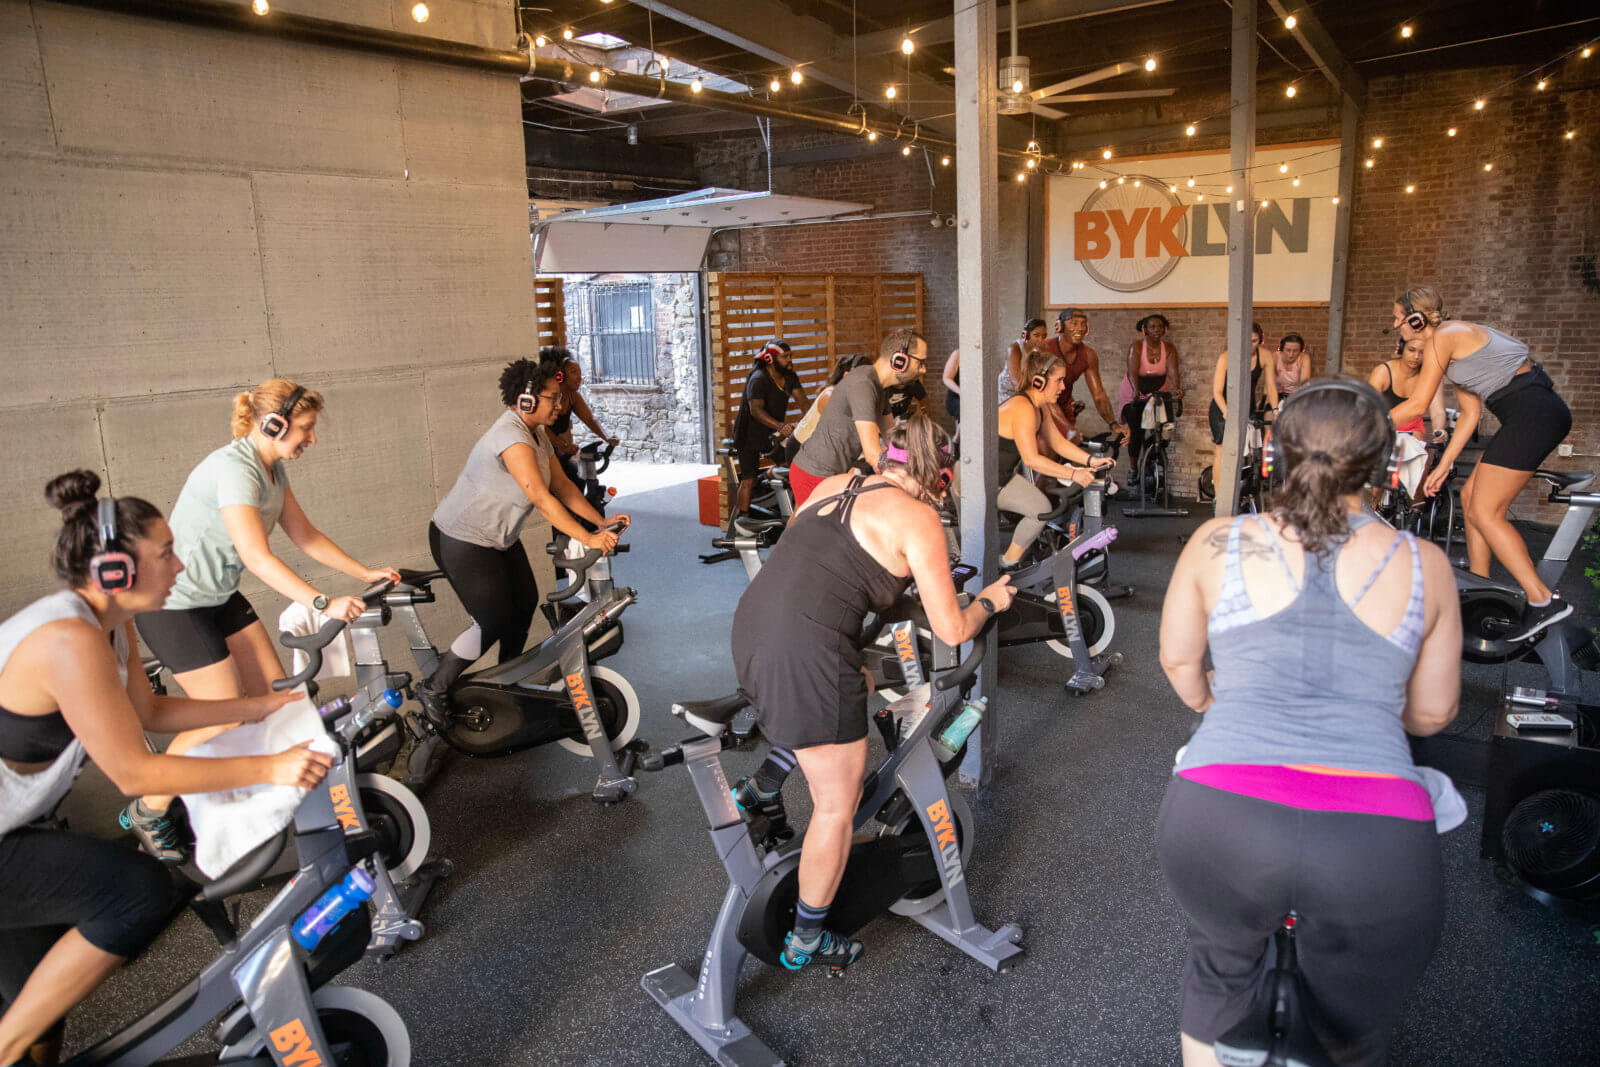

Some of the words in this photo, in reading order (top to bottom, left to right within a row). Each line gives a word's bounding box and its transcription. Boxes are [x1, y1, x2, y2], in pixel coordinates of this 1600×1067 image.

[1057, 586, 1080, 641] BYKLYN
[895, 629, 921, 691] BYKLYN
[566, 672, 602, 739] BYKLYN
[926, 798, 964, 889] BYKLYN
[269, 1018, 322, 1067] BY
